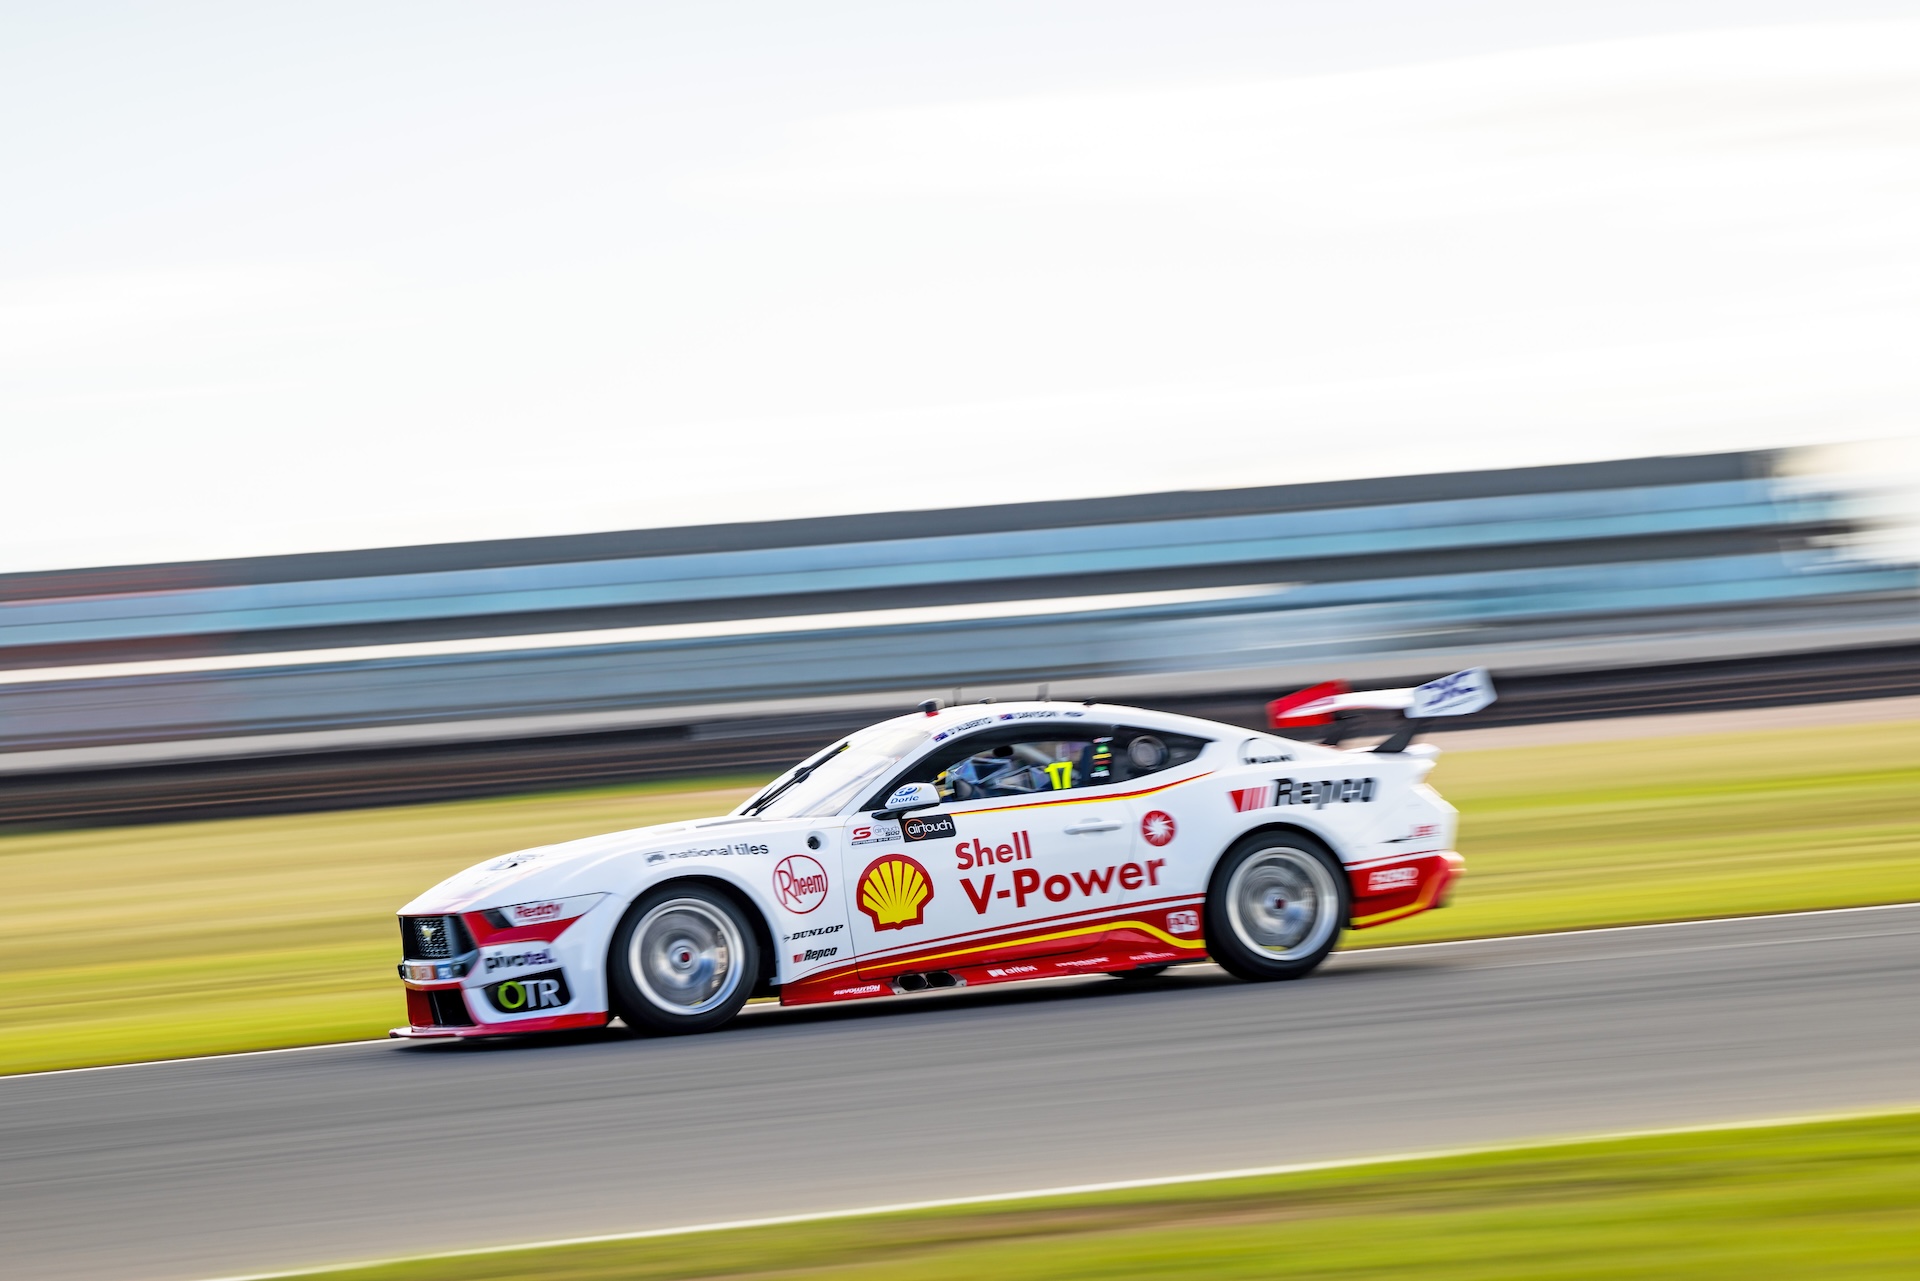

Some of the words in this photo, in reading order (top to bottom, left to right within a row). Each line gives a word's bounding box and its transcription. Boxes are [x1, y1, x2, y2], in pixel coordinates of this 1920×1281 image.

[1044, 761, 1073, 790] 17
[890, 795, 919, 804] Doric
[908, 820, 953, 835] airtouch
[669, 845, 733, 859] national
[735, 843, 769, 855] tiles
[955, 830, 1032, 870] Shell
[776, 859, 826, 905] Rheem
[959, 858, 1166, 915] V-Power
[791, 924, 844, 941] DUNLOP
[804, 947, 838, 962] Repco
[497, 979, 562, 1009] OTR
